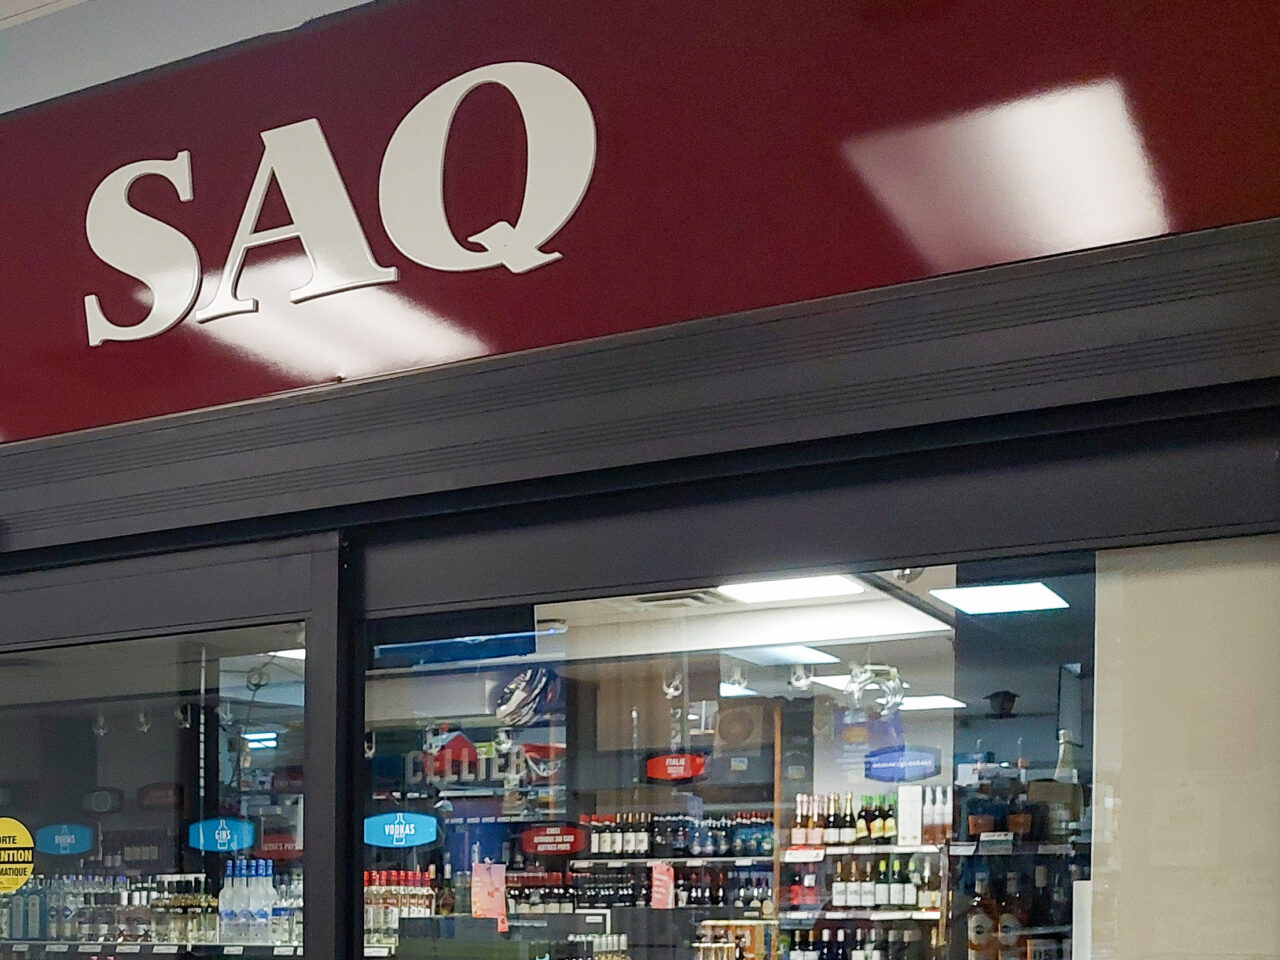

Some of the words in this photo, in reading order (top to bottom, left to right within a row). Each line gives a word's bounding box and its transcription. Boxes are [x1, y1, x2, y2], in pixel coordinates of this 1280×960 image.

[84, 60, 598, 347] SAQ
[215, 829, 231, 840] GINS
[384, 823, 416, 836] VODKAS
